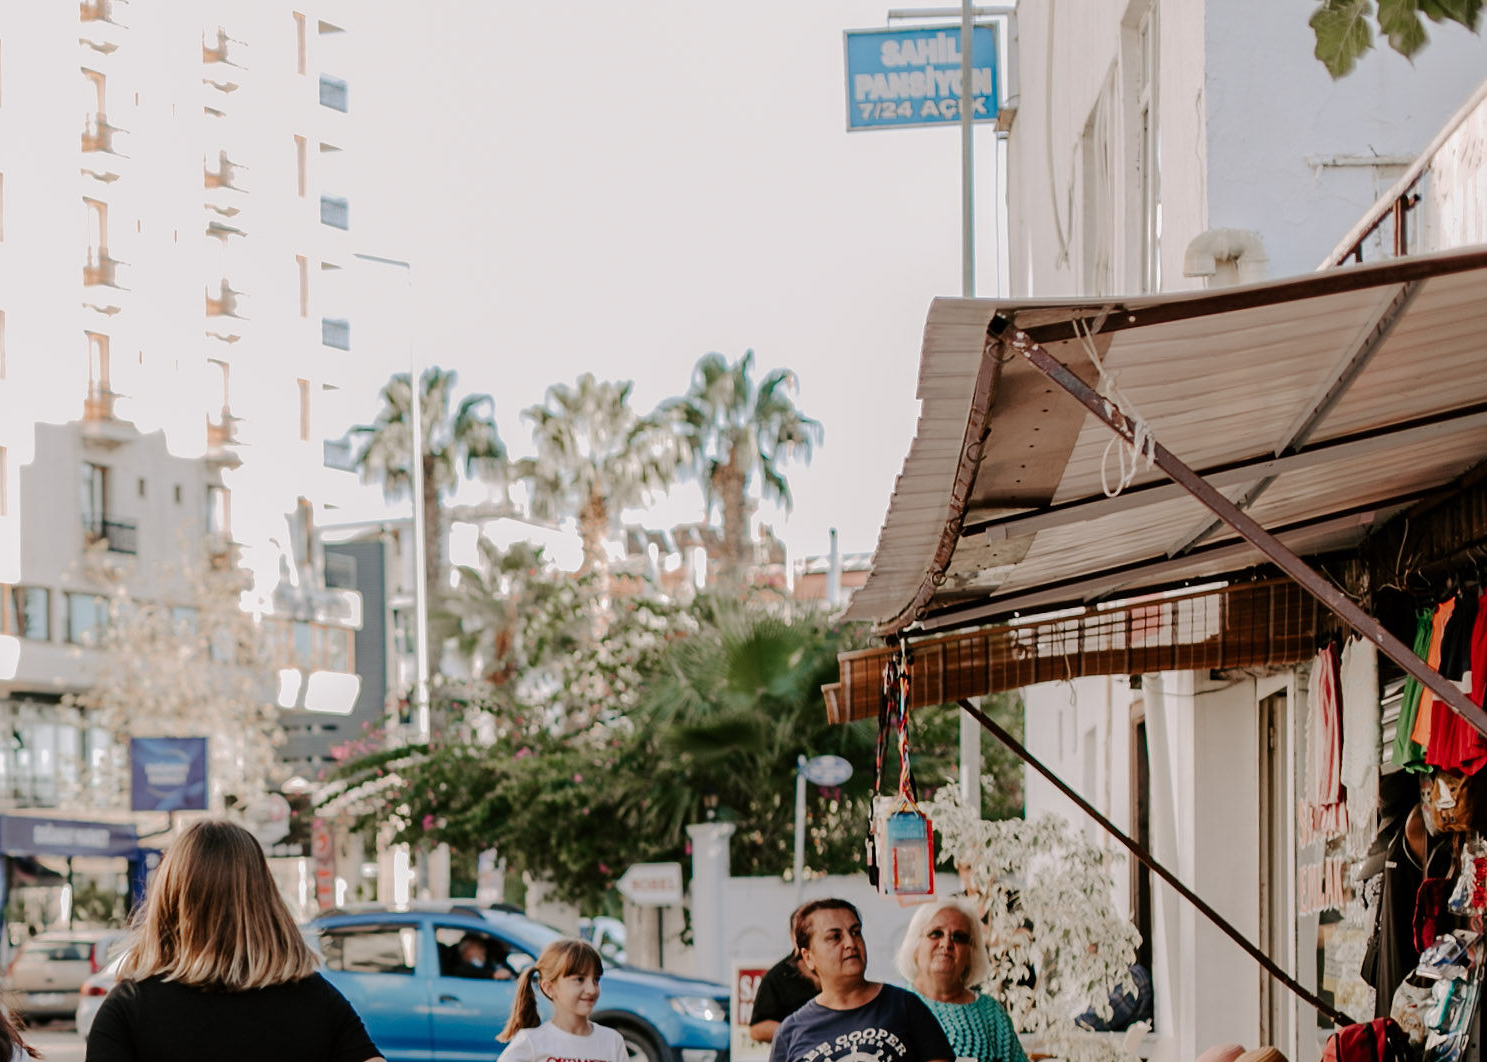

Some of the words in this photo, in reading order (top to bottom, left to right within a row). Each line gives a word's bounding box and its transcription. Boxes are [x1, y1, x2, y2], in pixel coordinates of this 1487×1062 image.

[882, 33, 962, 66] SAHİL
[858, 101, 913, 120] 7/24
[836, 1028, 906, 1056] COOPER
